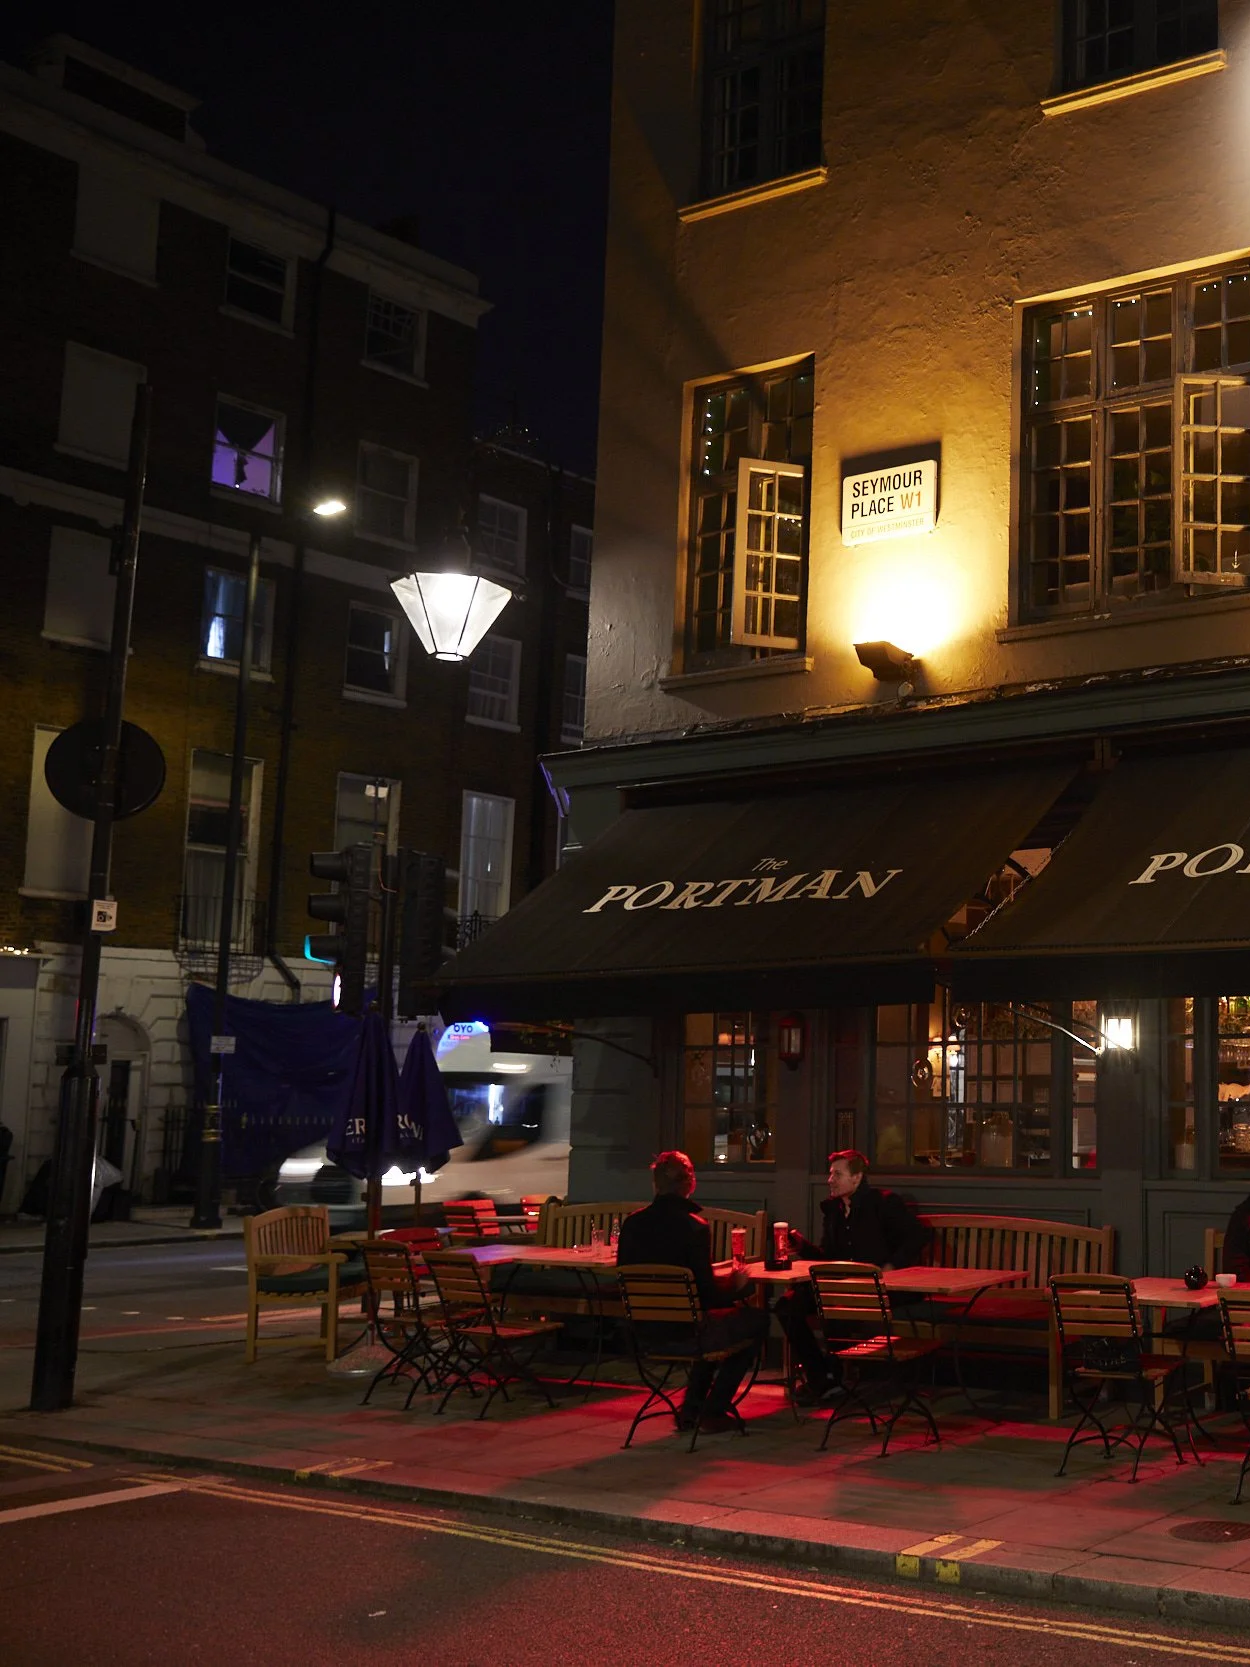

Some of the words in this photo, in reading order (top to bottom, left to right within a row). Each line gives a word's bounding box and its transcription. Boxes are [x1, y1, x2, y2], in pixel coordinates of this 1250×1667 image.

[852, 469, 923, 498] SEYMOUR
[851, 495, 895, 519] PLACE
[900, 491, 921, 510] W1
[850, 529, 865, 539] CITY
[867, 527, 874, 535] OF
[877, 517, 925, 533] WESTMINSTER
[752, 857, 788, 872] The
[582, 869, 904, 913] PORTMAN
